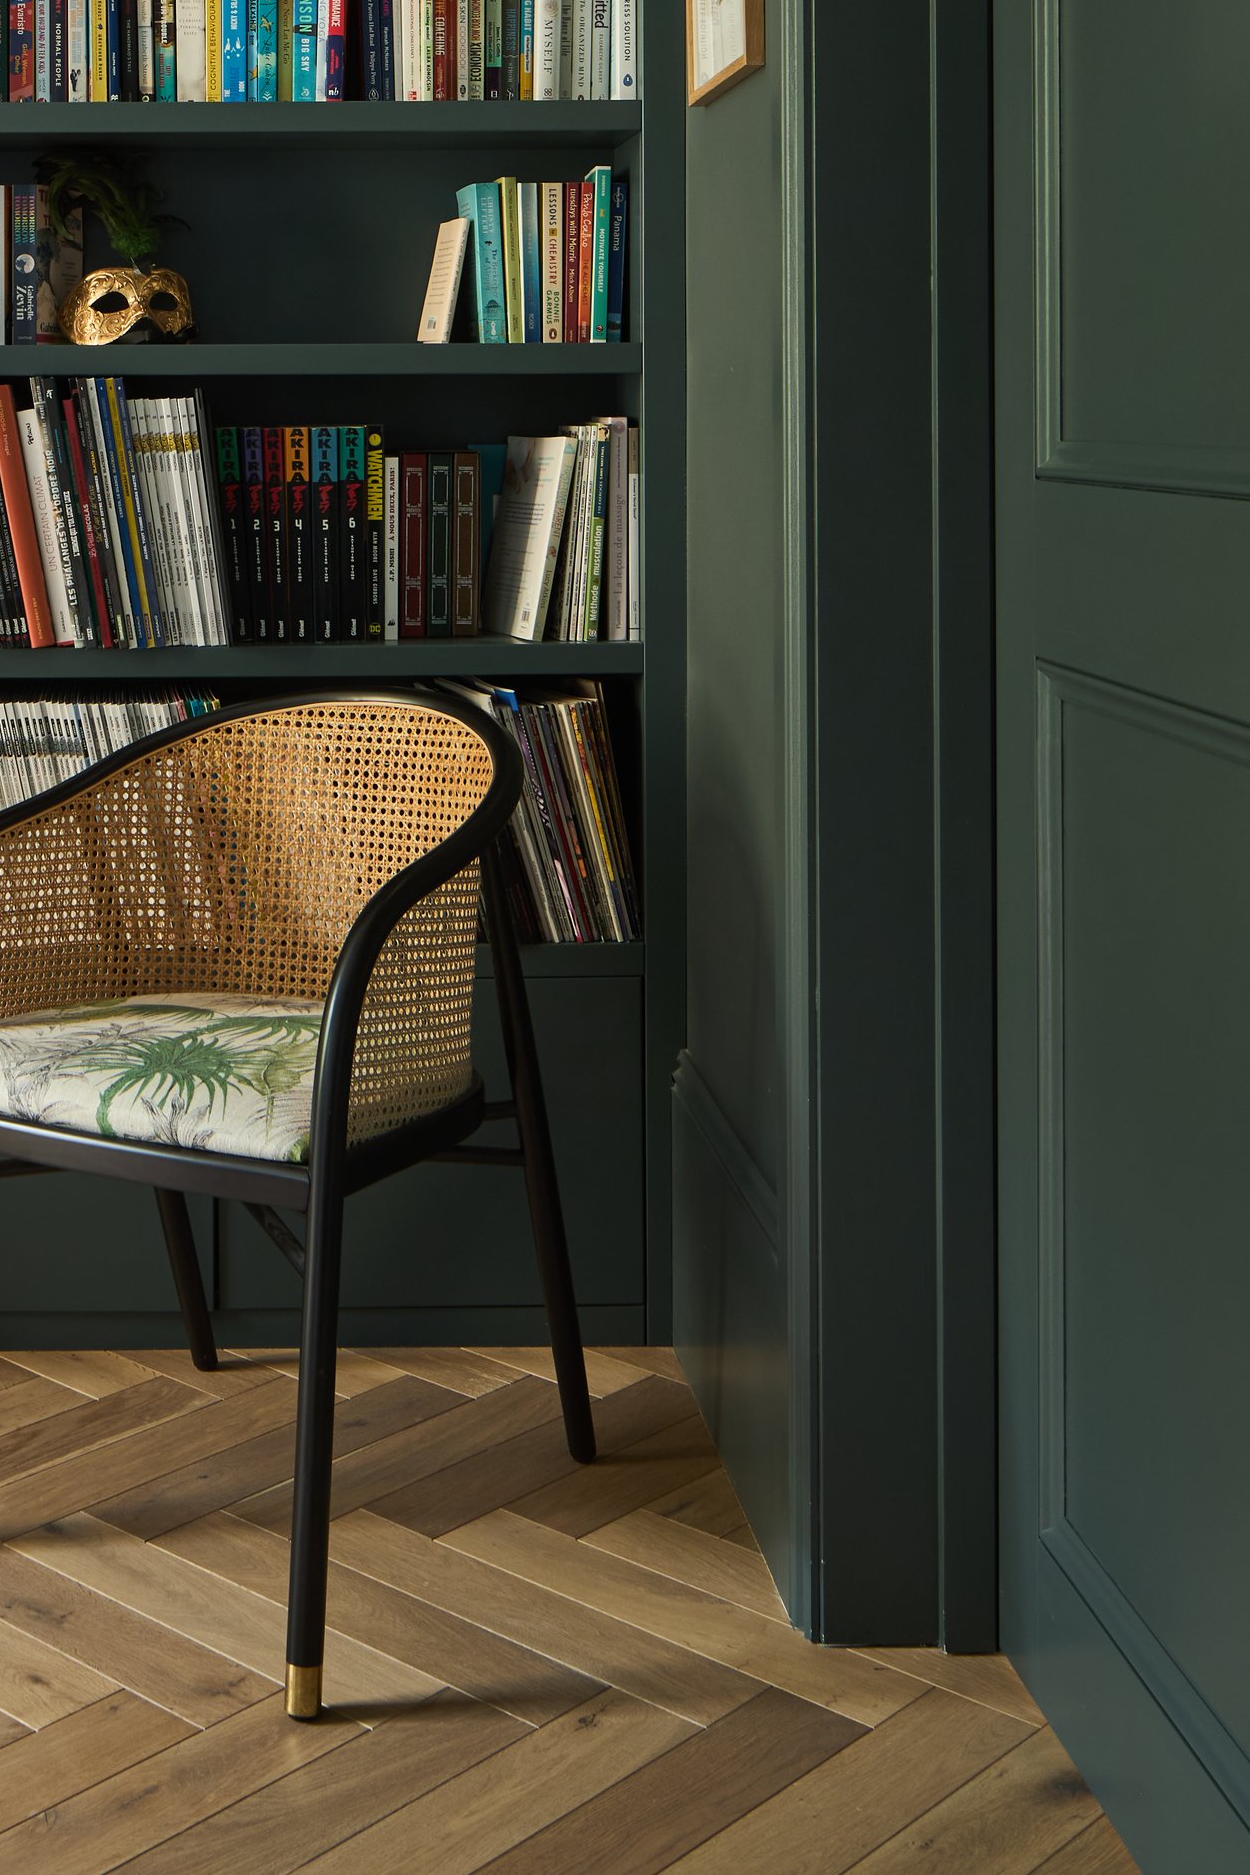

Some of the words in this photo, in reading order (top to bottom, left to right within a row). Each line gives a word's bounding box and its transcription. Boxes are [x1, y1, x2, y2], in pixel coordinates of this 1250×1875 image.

[17, 3, 26, 35] Evaristo
[301, 38, 310, 53] BIG
[301, 55, 310, 72] SKY
[543, 20, 553, 75] MYSELF
[549, 188, 557, 226] LESSONS
[612, 215, 622, 251] Panama
[549, 238, 557, 285] CHEMISTRY
[16, 285, 27, 320] Zevin
[289, 428, 306, 482] AKIRA
[317, 428, 333, 482] AKIRA
[344, 428, 360, 482] AKIRA
[367, 449, 383, 521] WATCHMEN
[322, 519, 329, 530] 5
[349, 517, 356, 529] 6
[593, 525, 603, 576] musculation
[589, 584, 599, 622] Méthode
